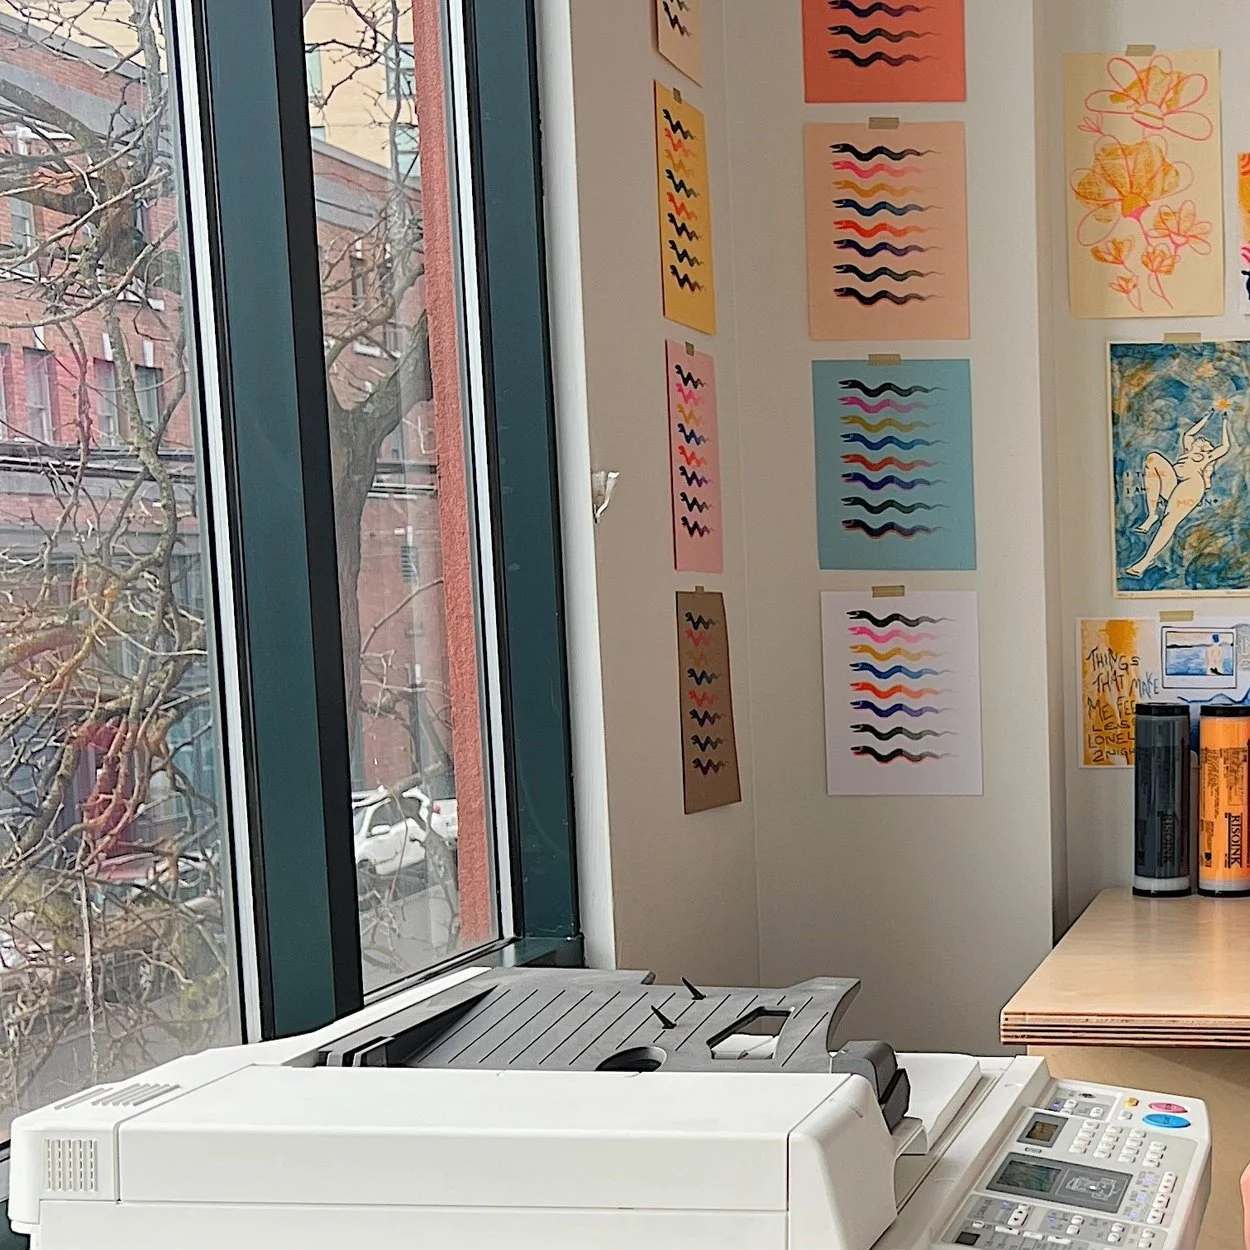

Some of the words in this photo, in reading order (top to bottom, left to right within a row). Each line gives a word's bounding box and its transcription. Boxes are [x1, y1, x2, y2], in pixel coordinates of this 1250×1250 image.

[1086, 646, 1142, 675] THINGS
[1092, 670, 1125, 694] THAT
[1129, 671, 1160, 700] MAKE
[1087, 697, 1114, 722] ME
[1117, 696, 1136, 719] FEE
[1087, 731, 1136, 749] LONEL
[1230, 814, 1241, 865] RISOINK
